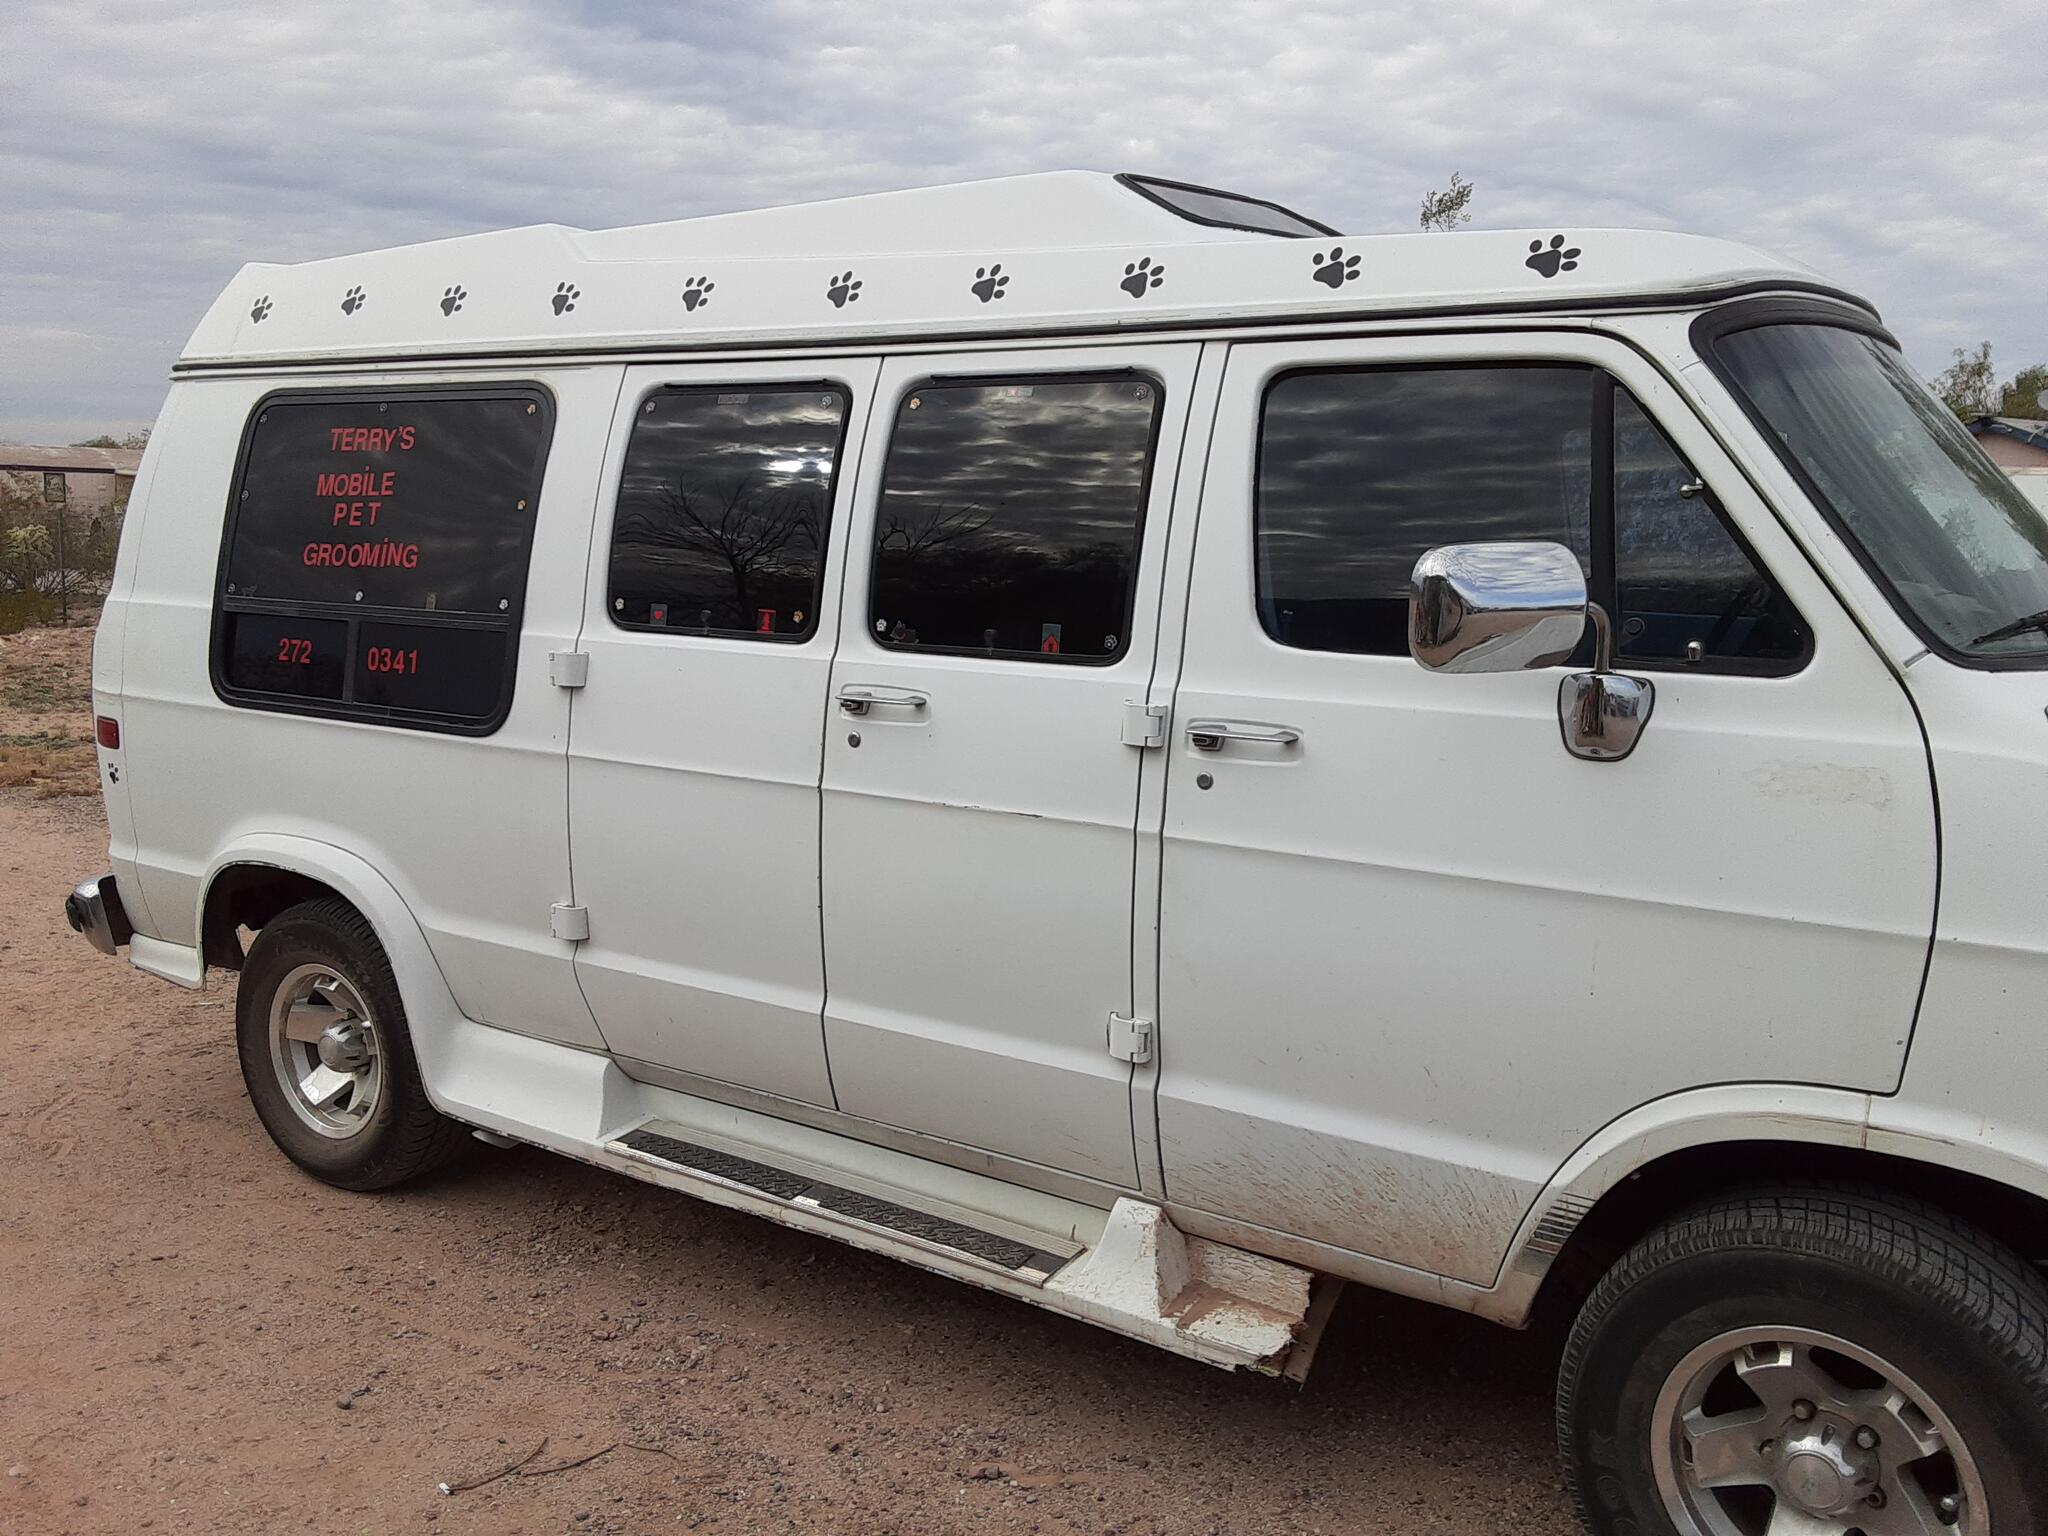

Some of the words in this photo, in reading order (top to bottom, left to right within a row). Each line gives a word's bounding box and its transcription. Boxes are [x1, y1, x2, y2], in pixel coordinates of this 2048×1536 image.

[331, 426, 416, 452] TERRY'S
[333, 501, 382, 526] PET
[278, 638, 312, 664] 272
[367, 647, 418, 674] 0341
